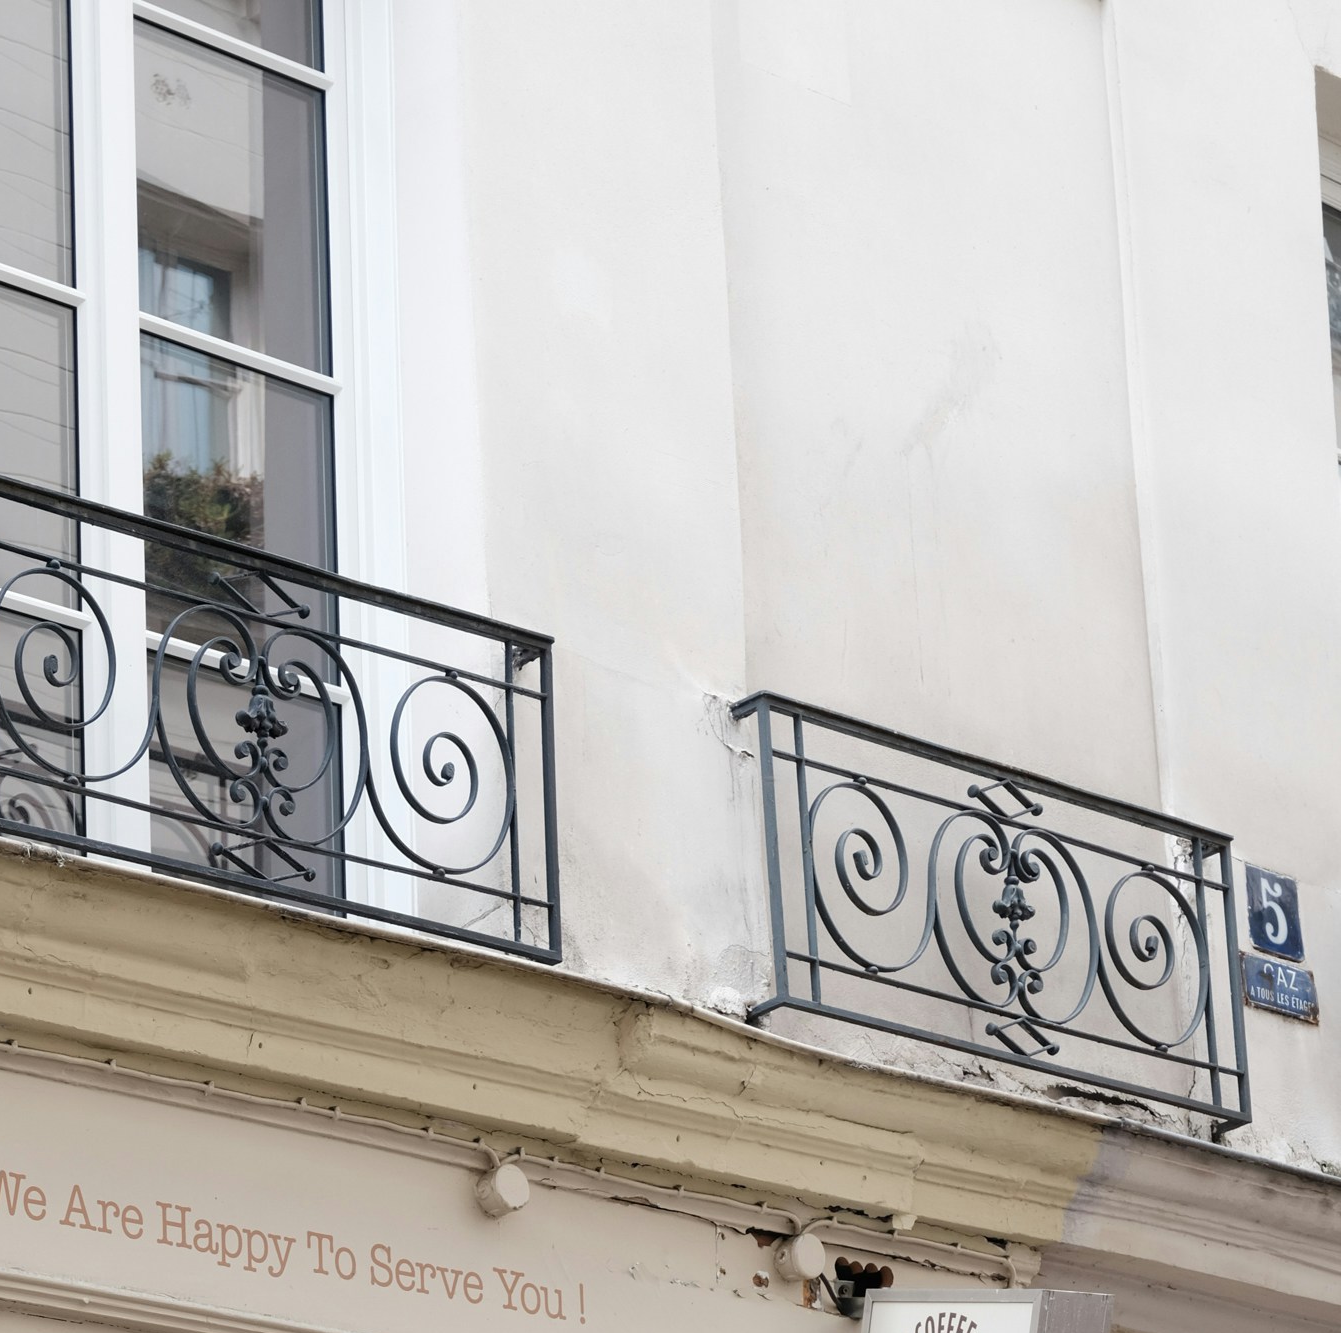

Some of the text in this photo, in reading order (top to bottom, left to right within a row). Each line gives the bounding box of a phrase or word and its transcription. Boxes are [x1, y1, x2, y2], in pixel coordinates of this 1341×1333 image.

[1260, 877, 1289, 945] 5
[1256, 987, 1275, 1002] TOUS
[1276, 992, 1290, 1007] LES
[60, 1184, 144, 1240] Are
[156, 1201, 296, 1277] Happy
[307, 1231, 357, 1281] To
[370, 1243, 484, 1304] Serve
[493, 1267, 566, 1319] You
